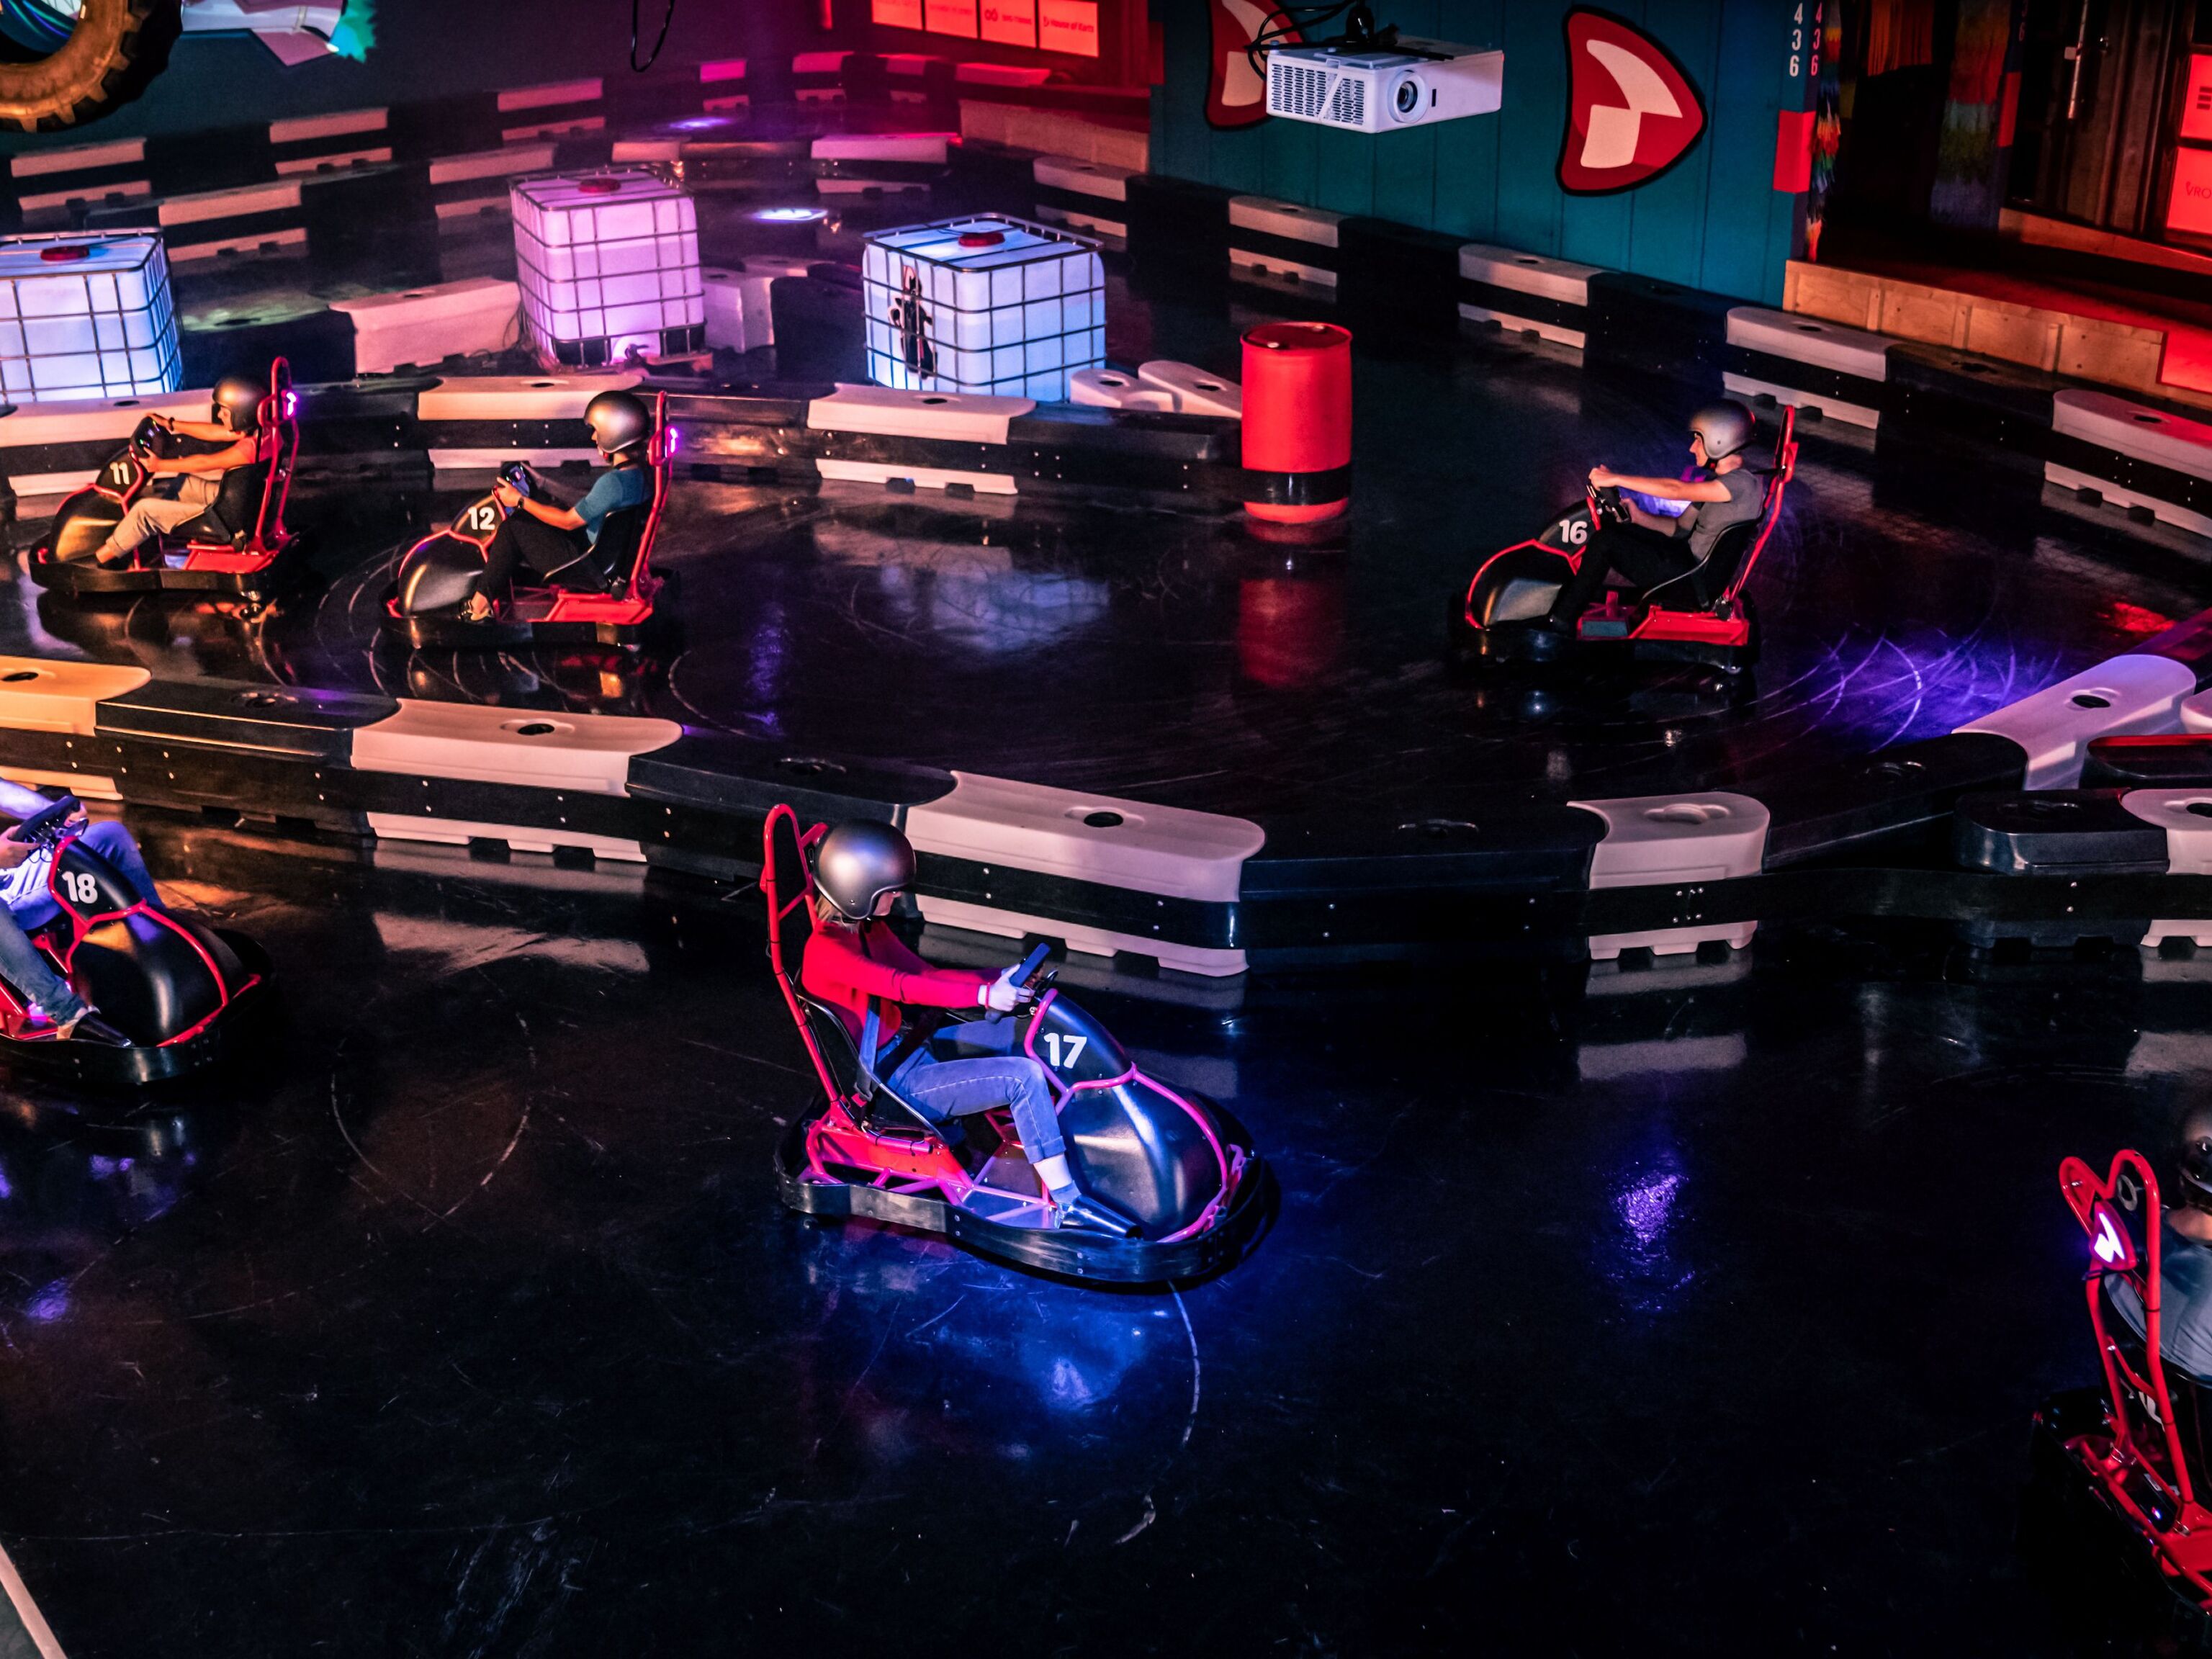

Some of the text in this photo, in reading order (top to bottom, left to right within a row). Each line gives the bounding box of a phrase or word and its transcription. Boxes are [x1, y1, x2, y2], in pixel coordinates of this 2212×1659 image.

[1051, 19, 1069, 29] House
[1071, 22, 1078, 30] of
[109, 462, 130, 485] 11
[467, 506, 495, 531] 12
[1558, 518, 1588, 545] 16
[61, 871, 98, 904] 18
[1043, 1032, 1087, 1069] 17
